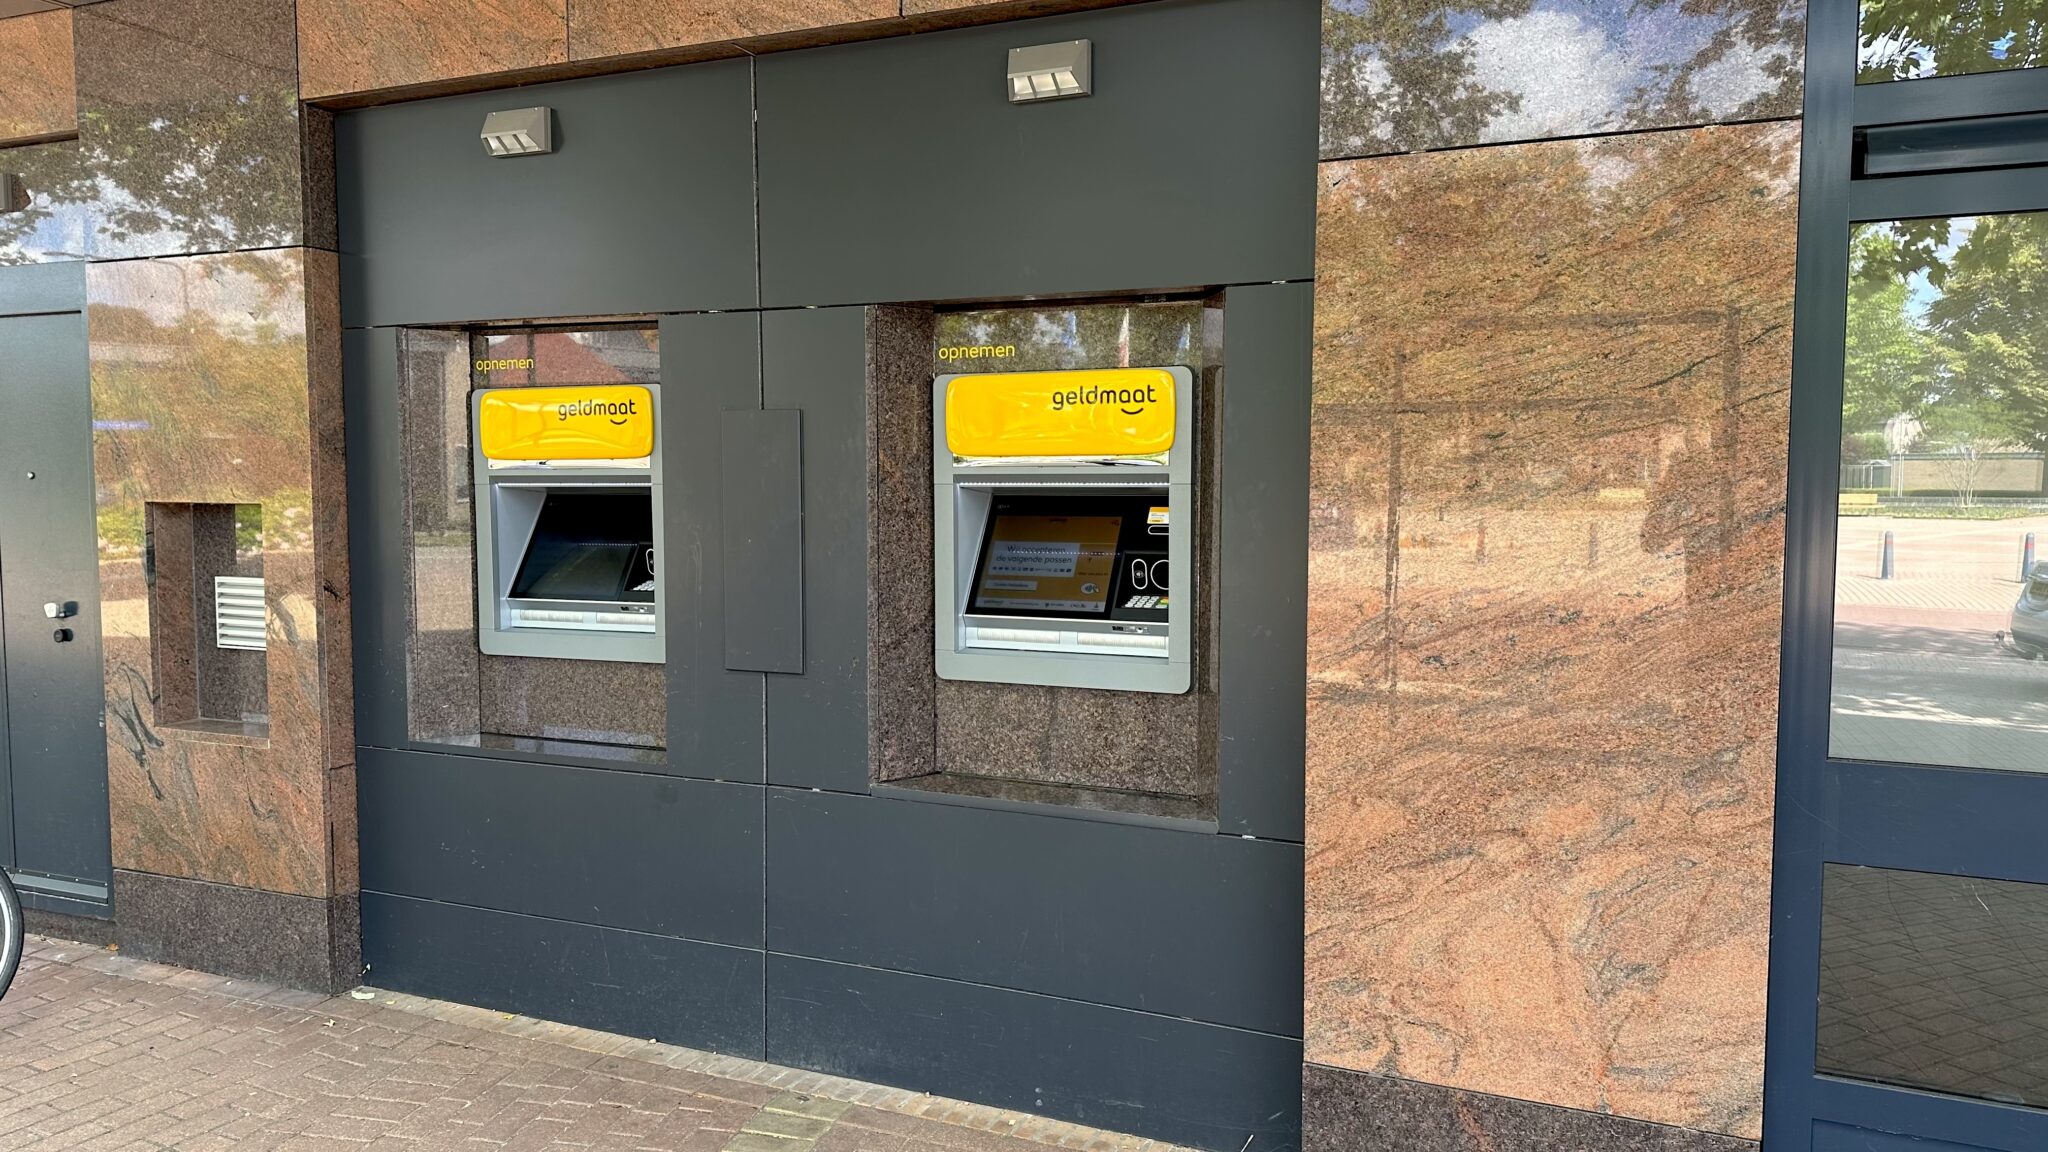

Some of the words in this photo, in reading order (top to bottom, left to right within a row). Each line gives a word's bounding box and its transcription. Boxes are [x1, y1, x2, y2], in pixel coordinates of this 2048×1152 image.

[938, 343, 1015, 363] opnemen
[476, 357, 534, 373] opnemen
[1052, 385, 1157, 411] geldmaat
[558, 400, 637, 421] geldmaat
